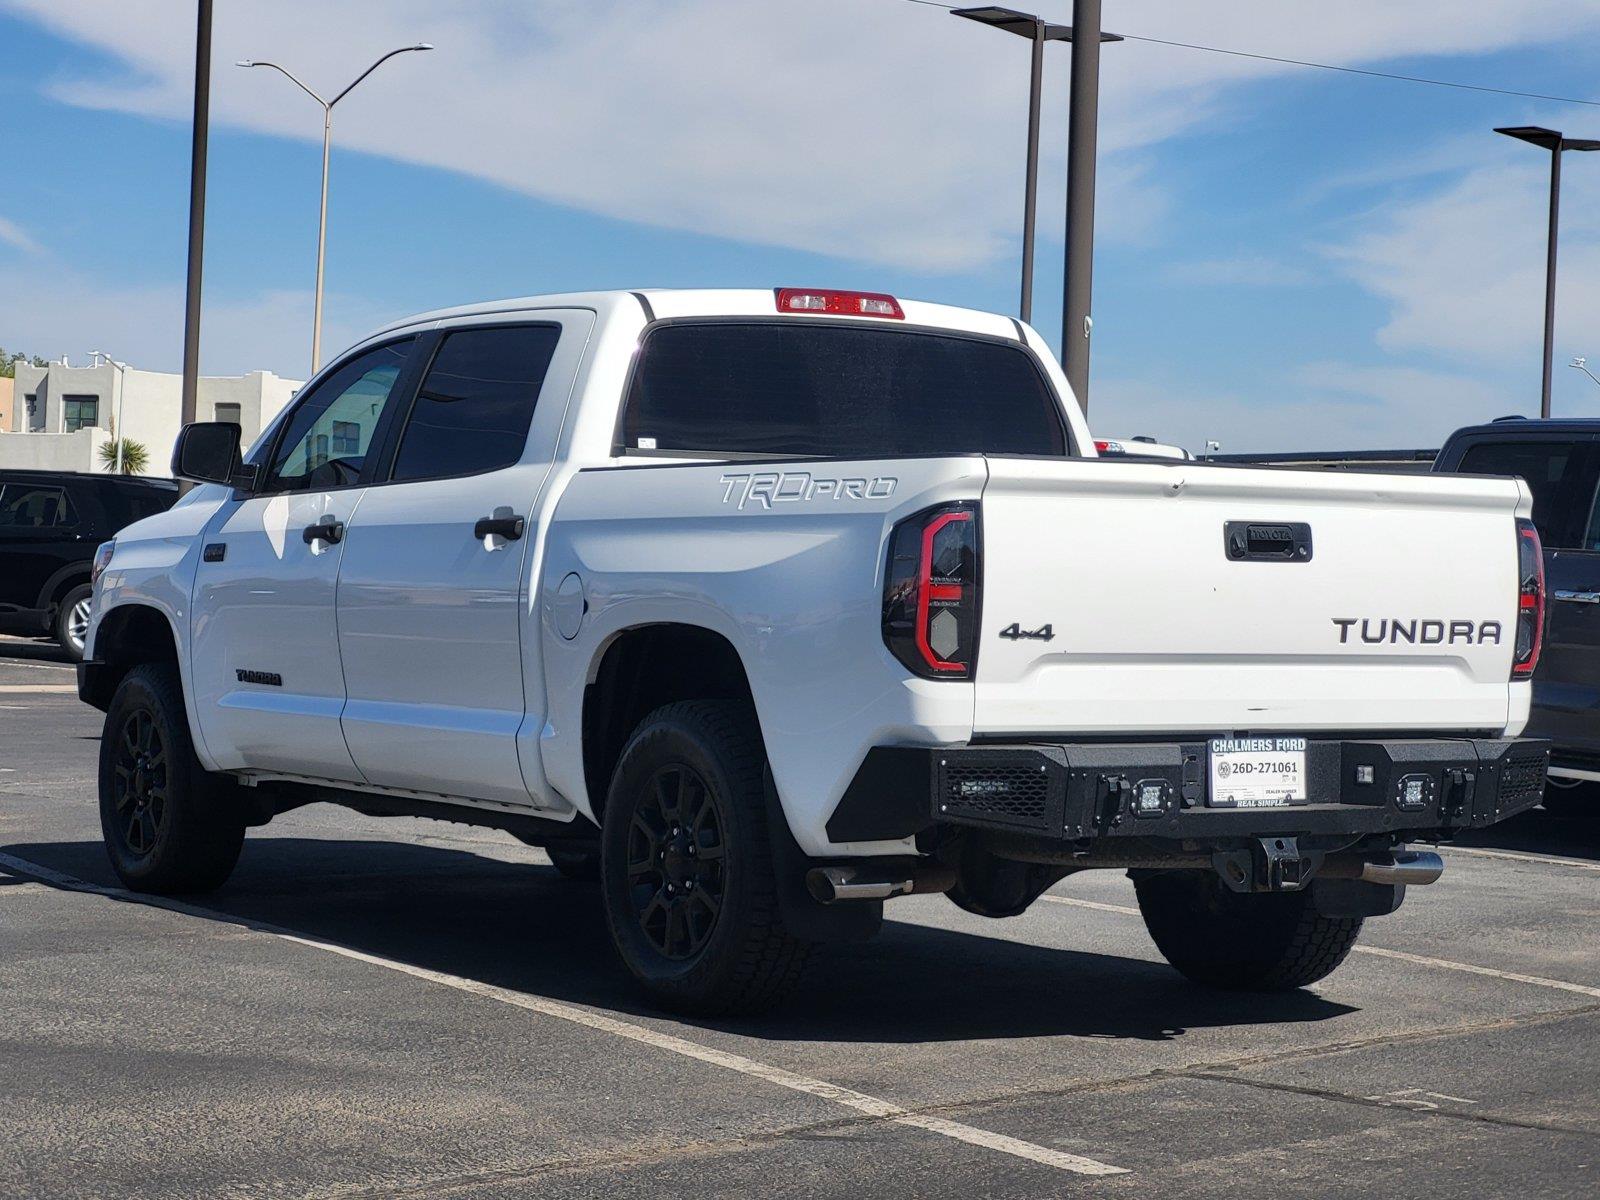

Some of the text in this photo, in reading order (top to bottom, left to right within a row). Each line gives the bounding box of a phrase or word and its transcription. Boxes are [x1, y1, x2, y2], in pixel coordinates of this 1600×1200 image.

[720, 472, 898, 511] TRD PRO
[1252, 528, 1292, 540] TOYOTA
[1331, 617, 1502, 645] TUNDRA
[235, 668, 282, 687] TUNDRA
[1212, 738, 1306, 753] CHALMERS FORD
[1232, 762, 1297, 774] 26D-271061
[1237, 800, 1256, 808] REAL
